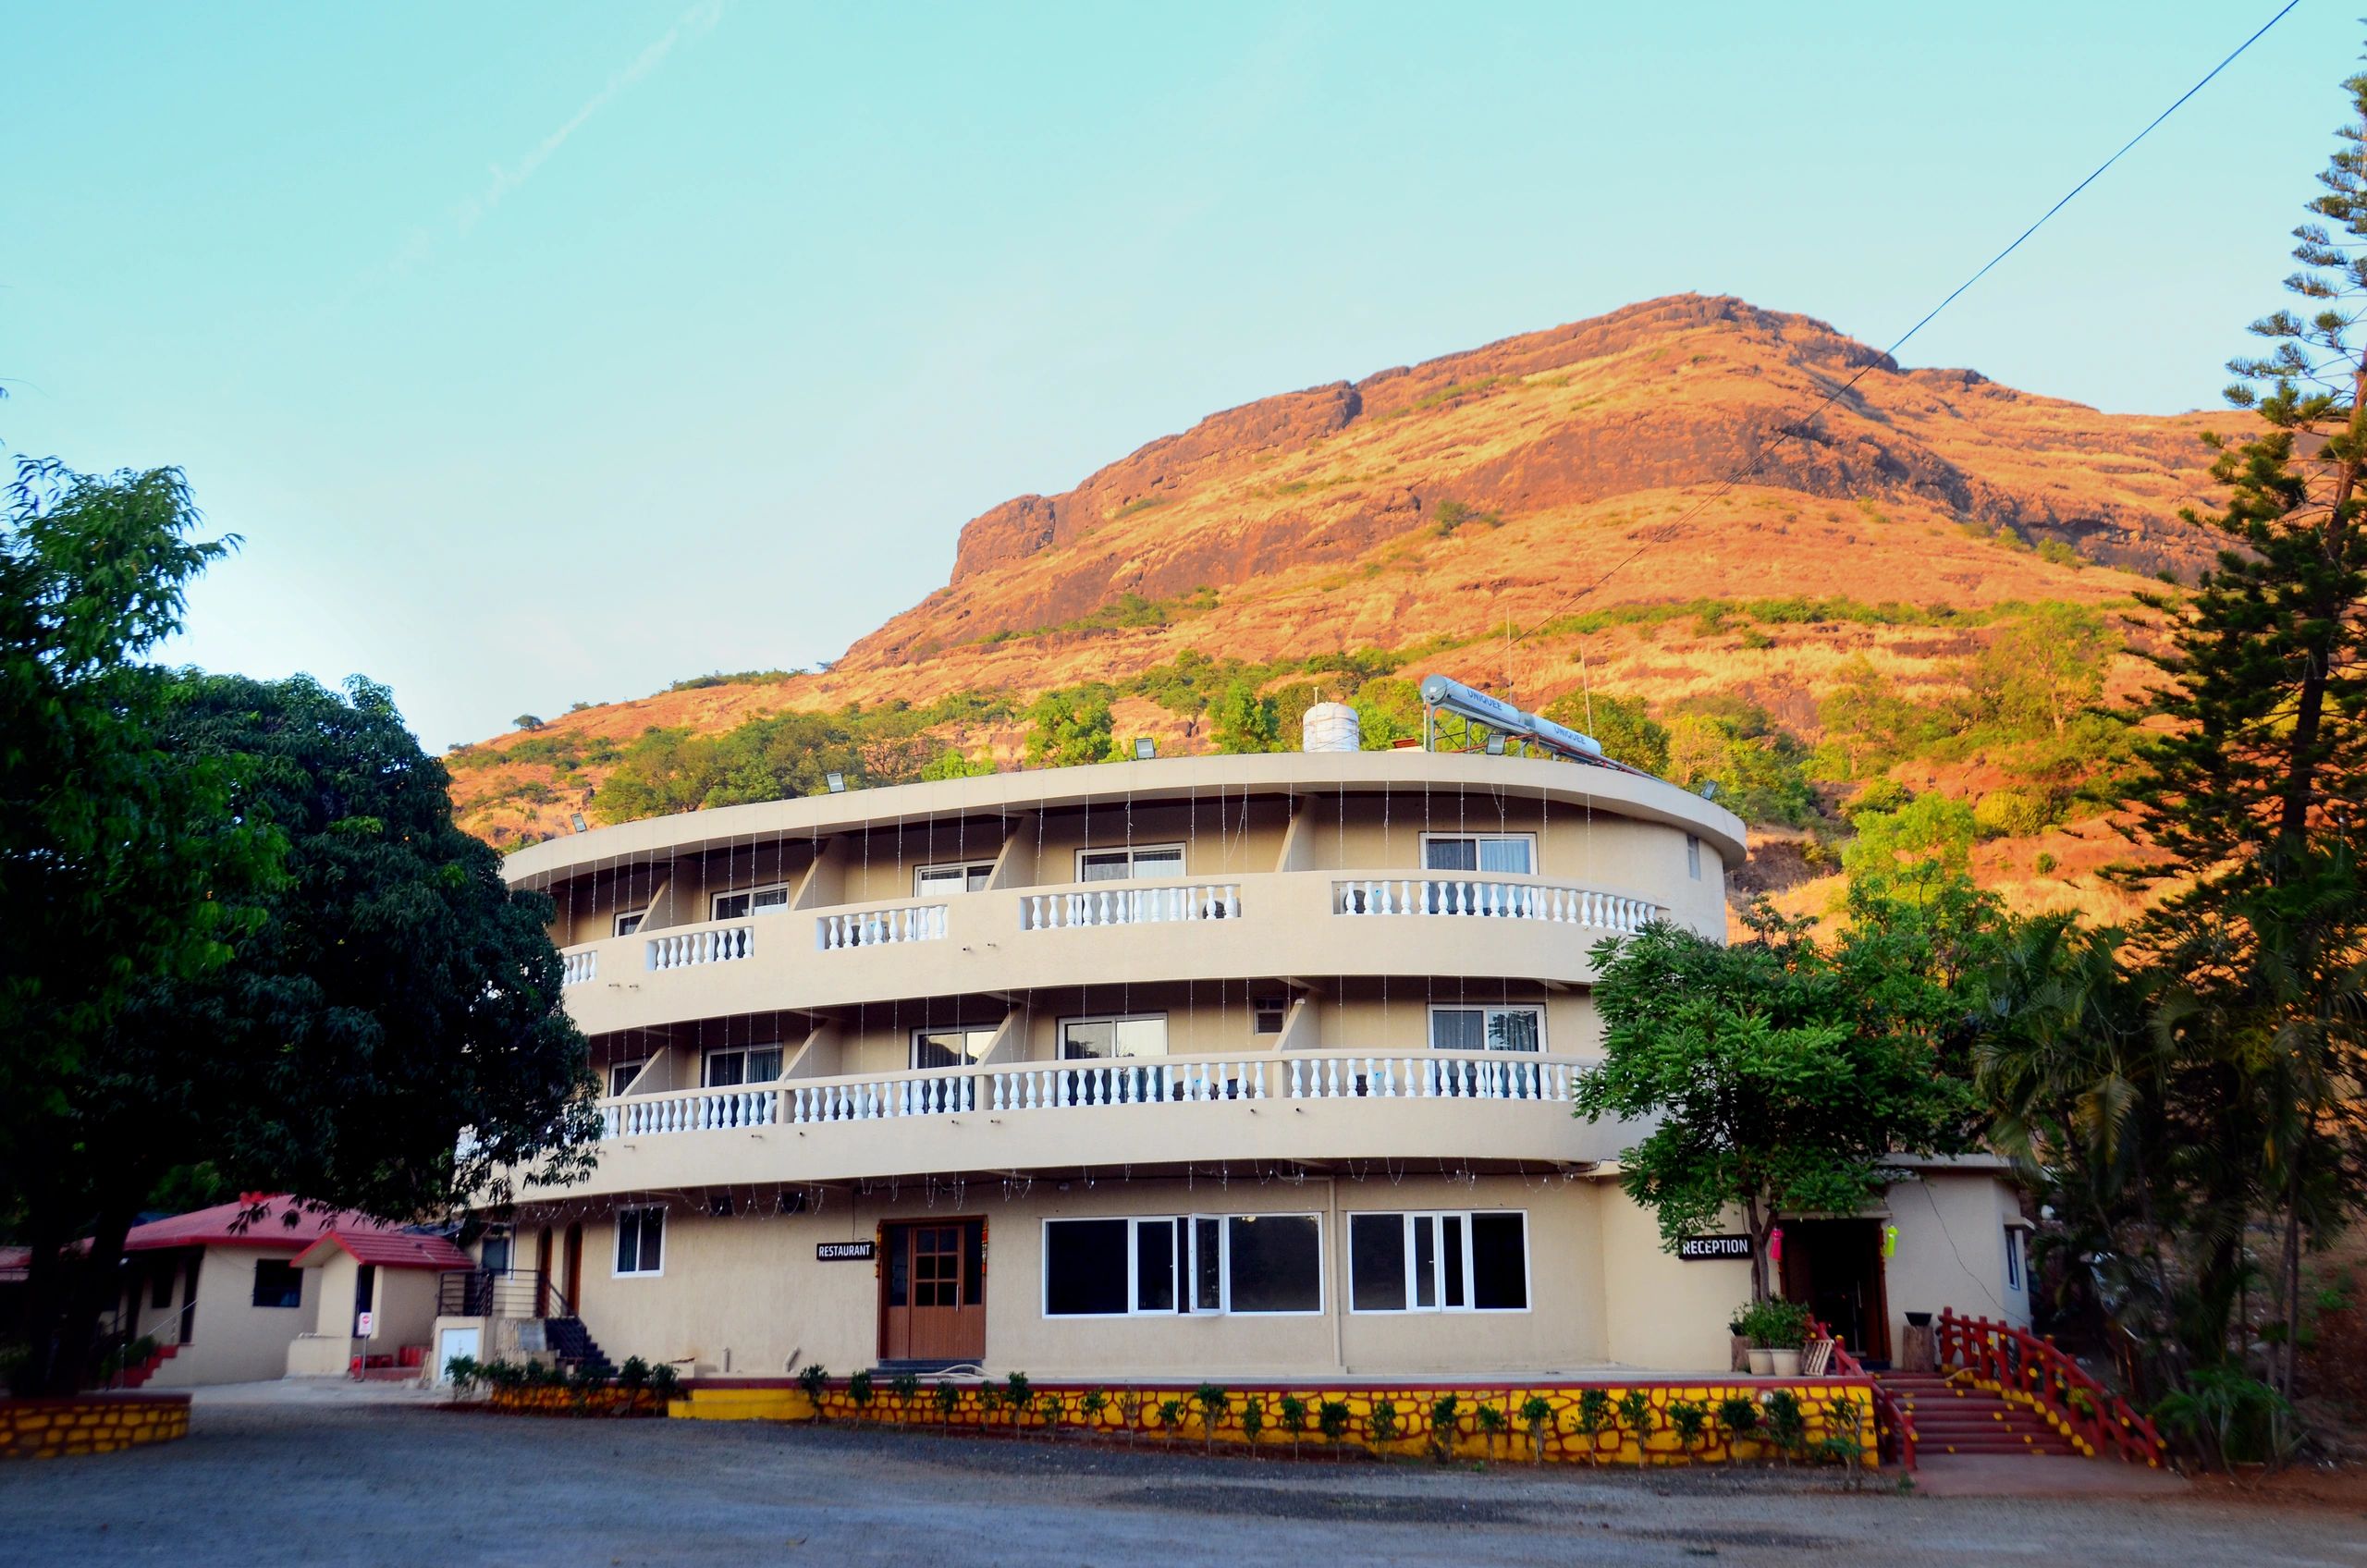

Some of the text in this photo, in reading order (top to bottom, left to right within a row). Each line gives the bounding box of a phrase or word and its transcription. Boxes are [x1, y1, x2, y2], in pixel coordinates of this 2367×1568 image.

[1466, 688, 1502, 711] UNIQUEE
[1553, 725, 1586, 745] UNIQUEE
[818, 1244, 871, 1257] RESTAURANT
[1682, 1239, 1748, 1255] RECEPTION
